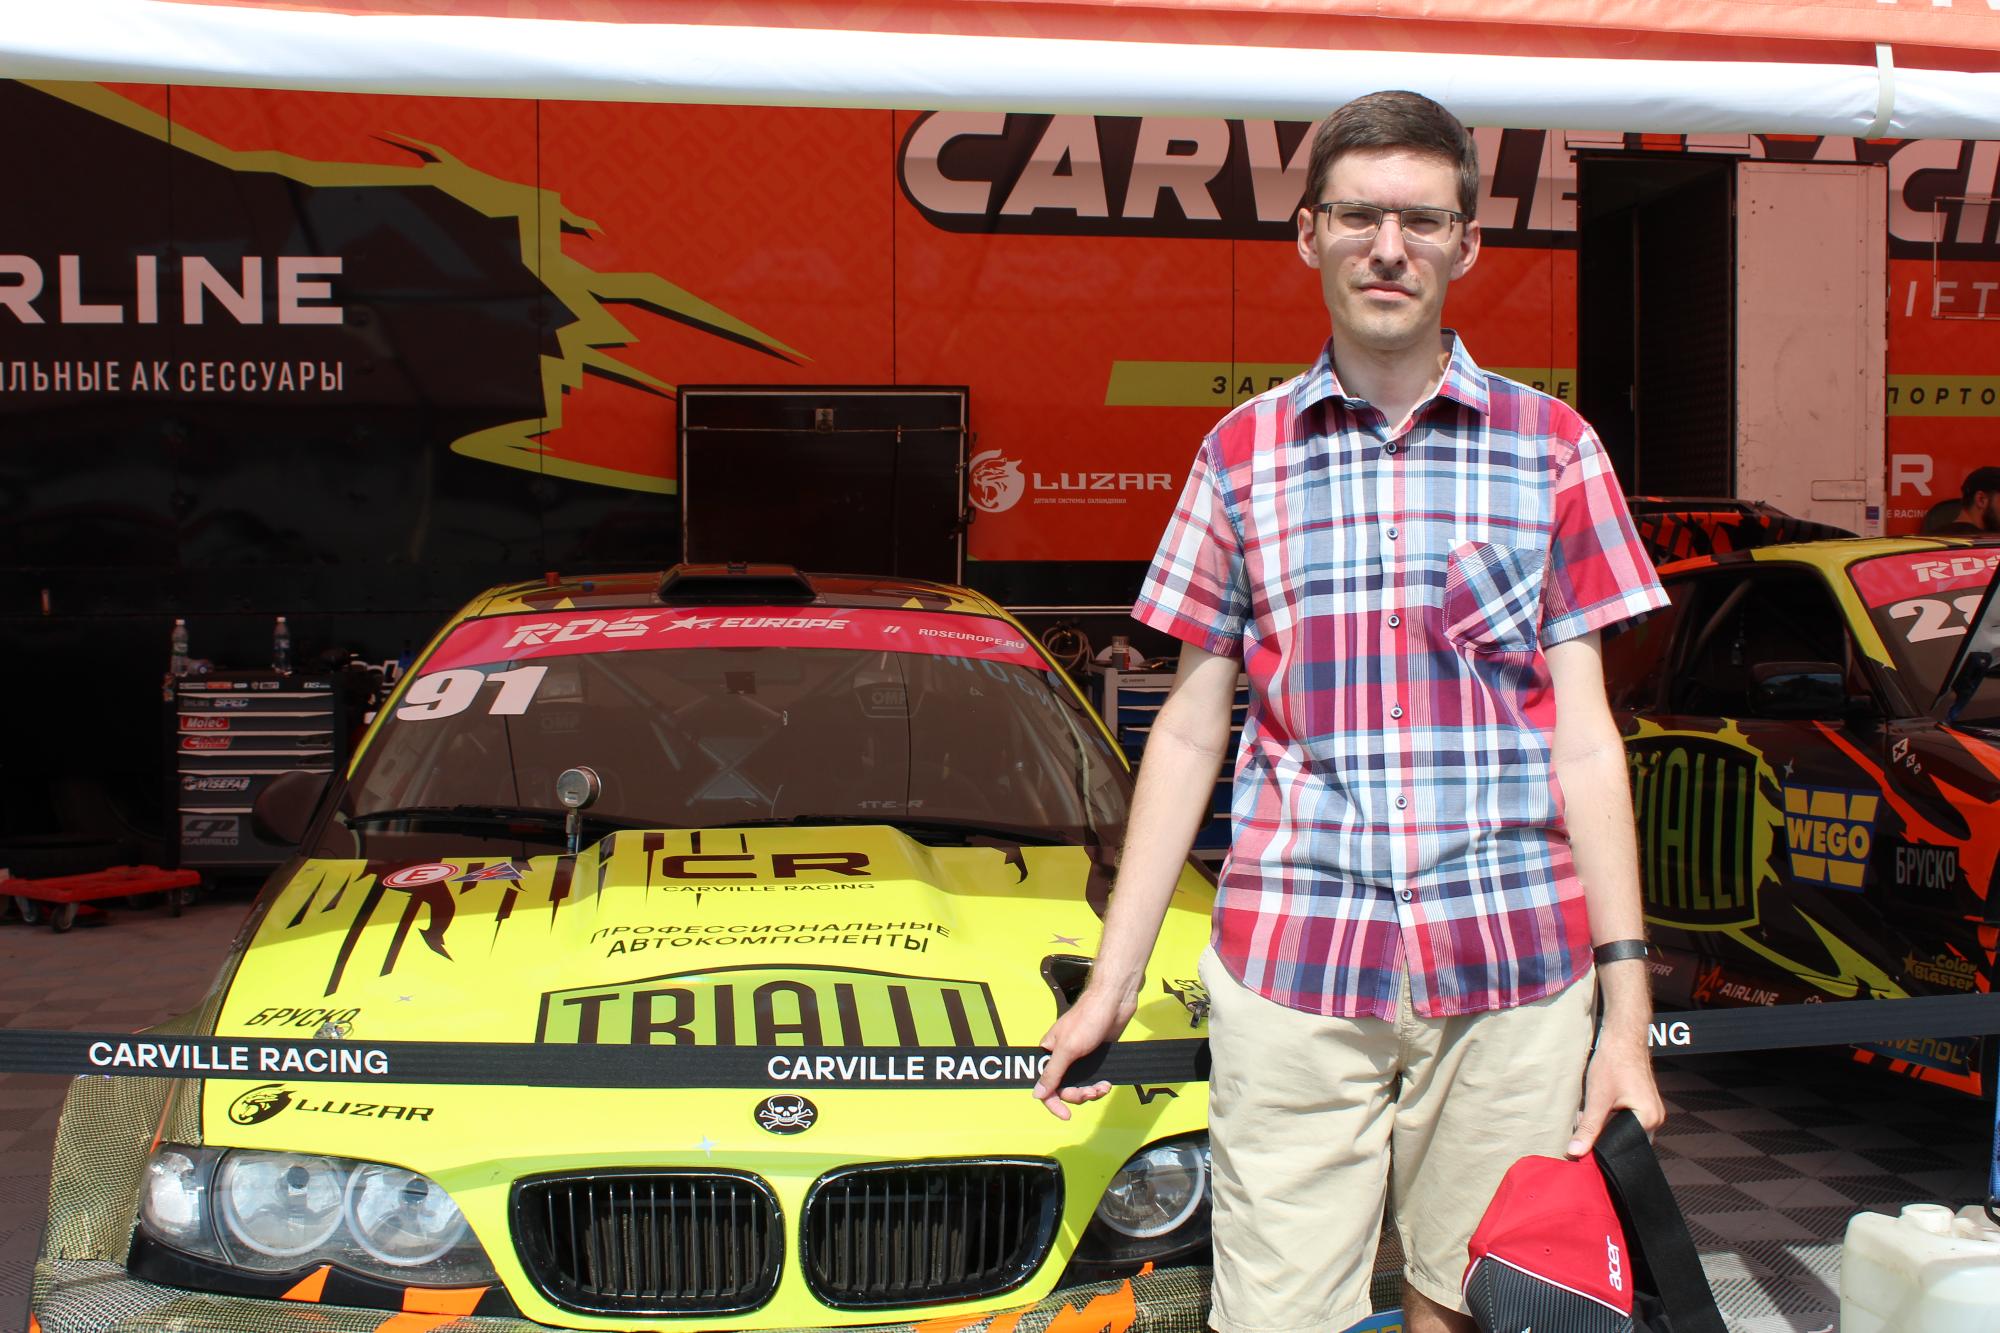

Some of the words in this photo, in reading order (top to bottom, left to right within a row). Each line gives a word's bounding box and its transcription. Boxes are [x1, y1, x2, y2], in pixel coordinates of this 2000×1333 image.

[0, 362, 120, 391] ЛЬНЫЕ
[1033, 472, 1173, 490] LUZAR
[1894, 509, 1928, 519] RACIN
[502, 615, 662, 649] RDS
[719, 617, 851, 629] EUROPE
[918, 628, 1026, 650] RDSEUROPE.RU
[396, 665, 549, 721] 91
[1786, 817, 1870, 859] WEGO
[662, 852, 872, 879] CR
[1895, 846, 1956, 890] БРУСКО
[784, 883, 875, 891] RACING
[590, 922, 951, 944] ПРОФЕССИОНАЛЬНЫЕ
[607, 933, 929, 958] АВТОКОМПОНЕНТЫ
[1935, 954, 1978, 974] Color
[1914, 965, 1975, 991] Blaster
[1719, 982, 1780, 1007] AIRLINE
[89, 1042, 249, 1071] CARVILLE
[259, 1047, 389, 1075] RACING
[767, 1055, 925, 1081] CARVILLE
[295, 1099, 435, 1122] LUZAR
[1606, 1235, 1623, 1291] acer
